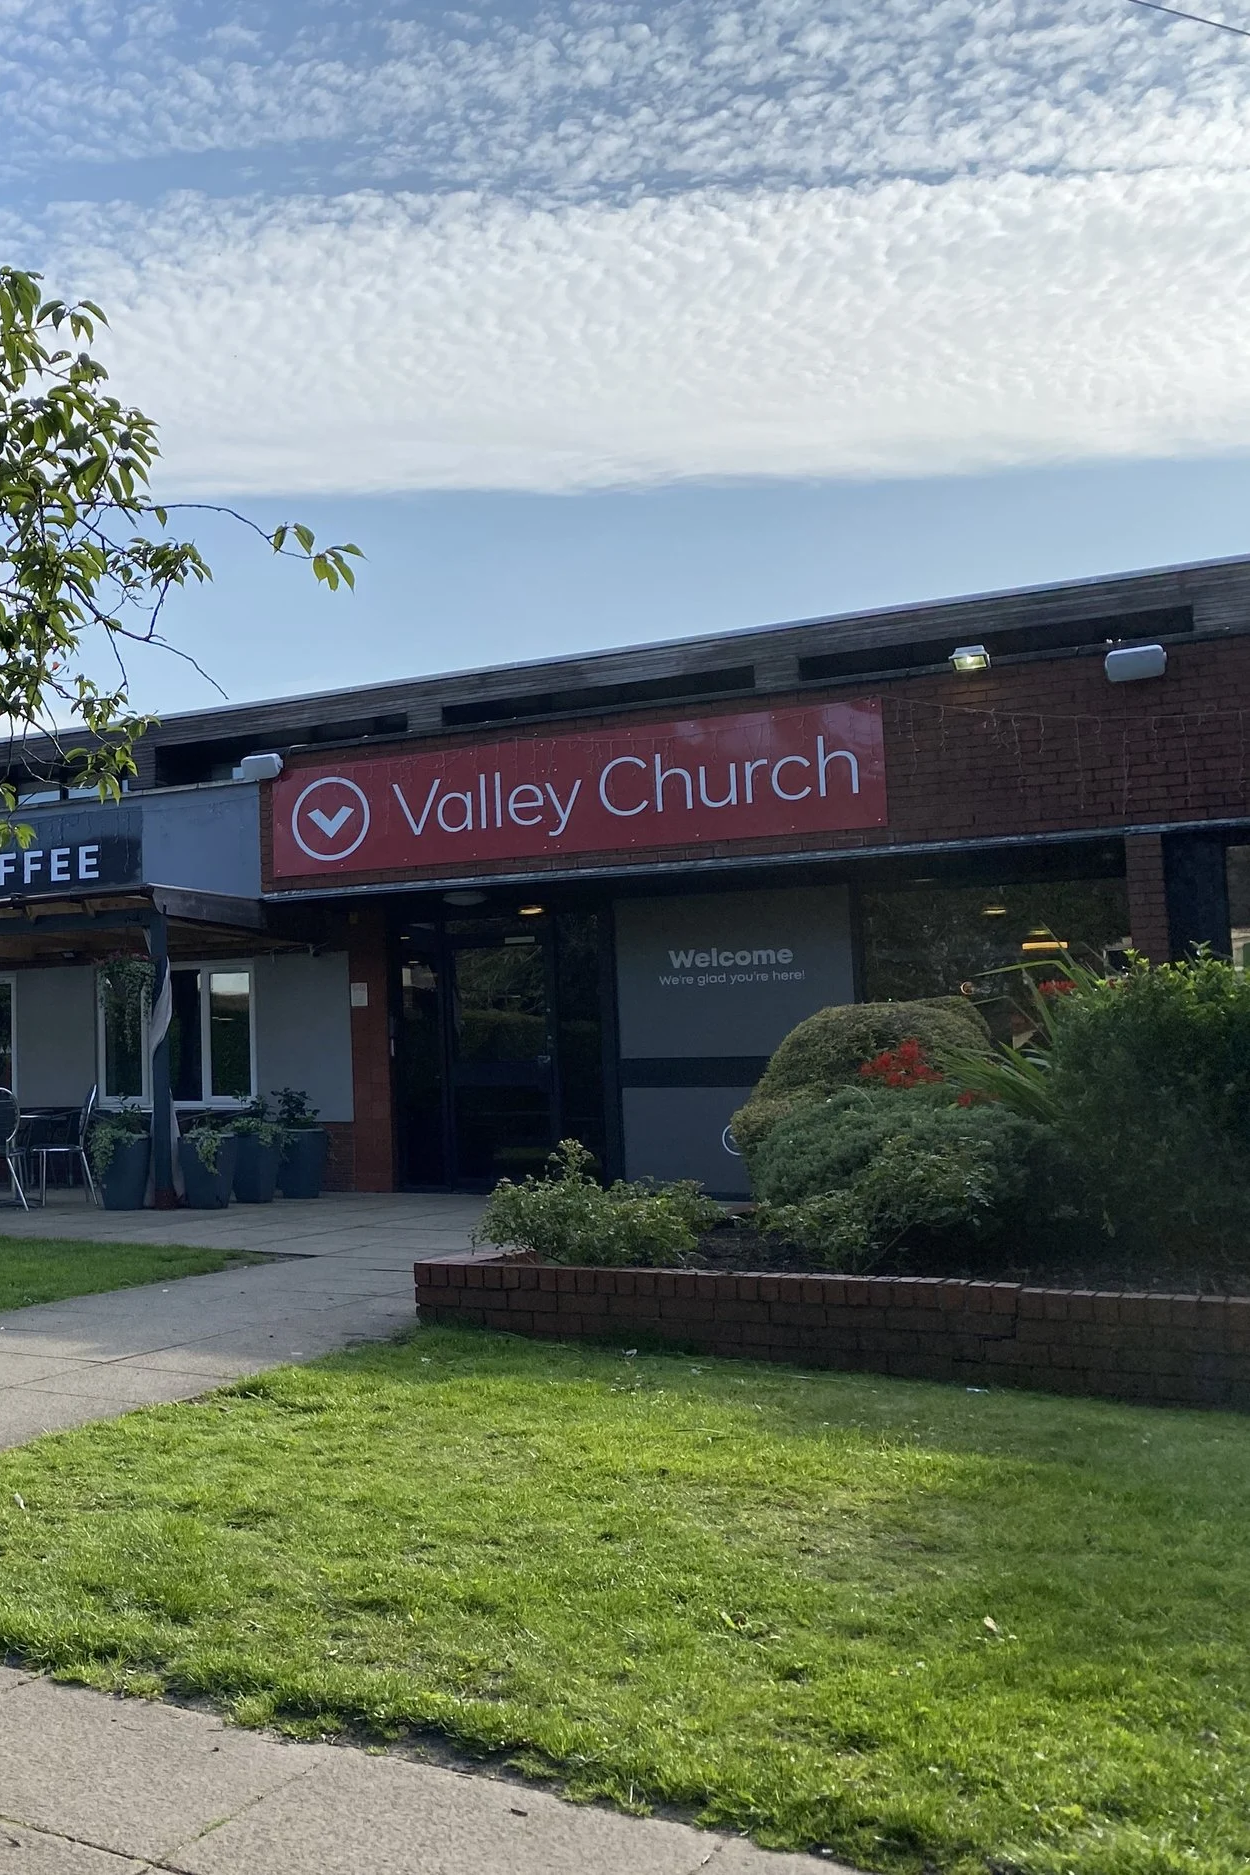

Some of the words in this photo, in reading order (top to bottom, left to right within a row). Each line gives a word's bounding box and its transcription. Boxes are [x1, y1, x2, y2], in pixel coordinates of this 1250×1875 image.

[392, 771, 582, 837] Valley
[598, 735, 860, 817] Church
[668, 947, 794, 969] Welcome
[658, 974, 694, 986] We're
[697, 972, 727, 987] glad
[729, 971, 769, 985] you're
[772, 969, 806, 981] here!
